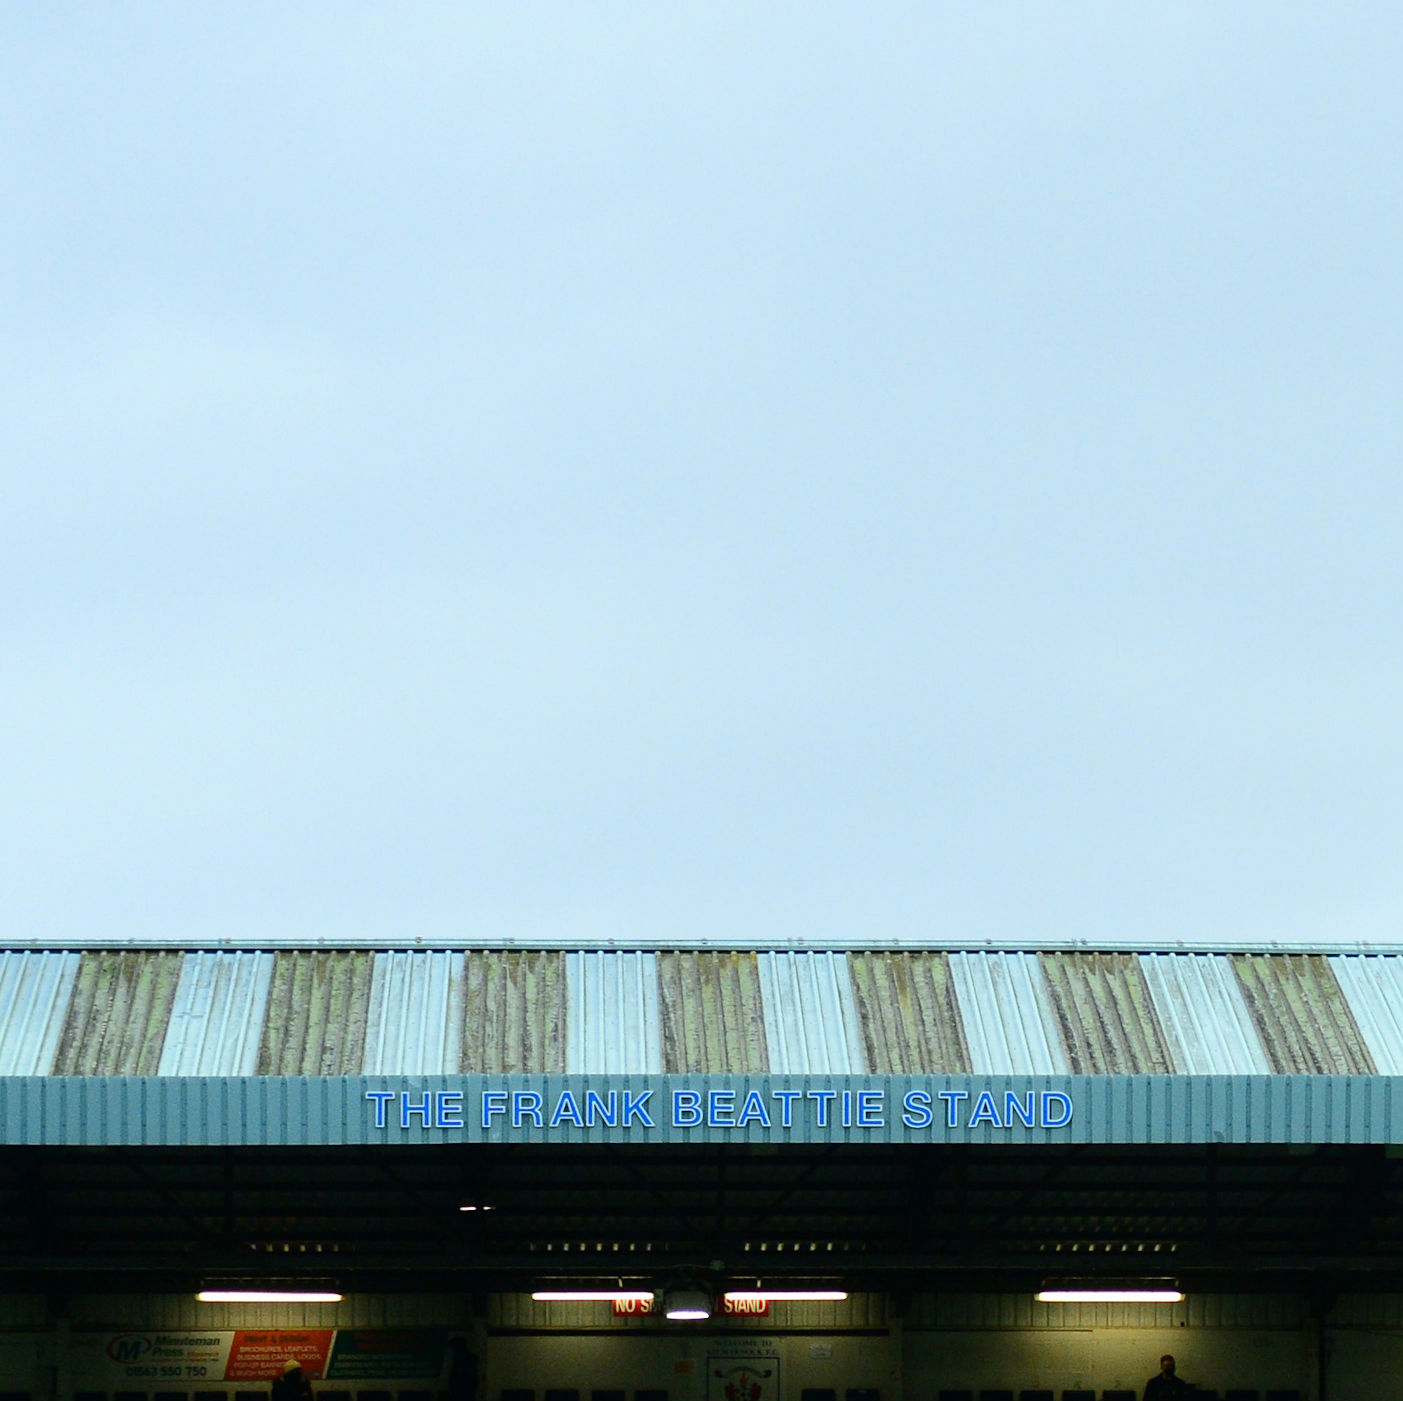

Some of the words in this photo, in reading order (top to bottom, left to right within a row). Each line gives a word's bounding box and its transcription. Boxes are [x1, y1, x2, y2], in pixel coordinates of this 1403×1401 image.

[366, 1091, 464, 1128] THE
[481, 1090, 655, 1128] FRANK
[671, 1090, 884, 1128] BEATTIE
[902, 1091, 1074, 1128] STAND
[724, 1298, 766, 1313] STAND
[154, 1336, 220, 1346] Minuteman
[161, 1367, 182, 1376] 550
[185, 1367, 207, 1376] 750
